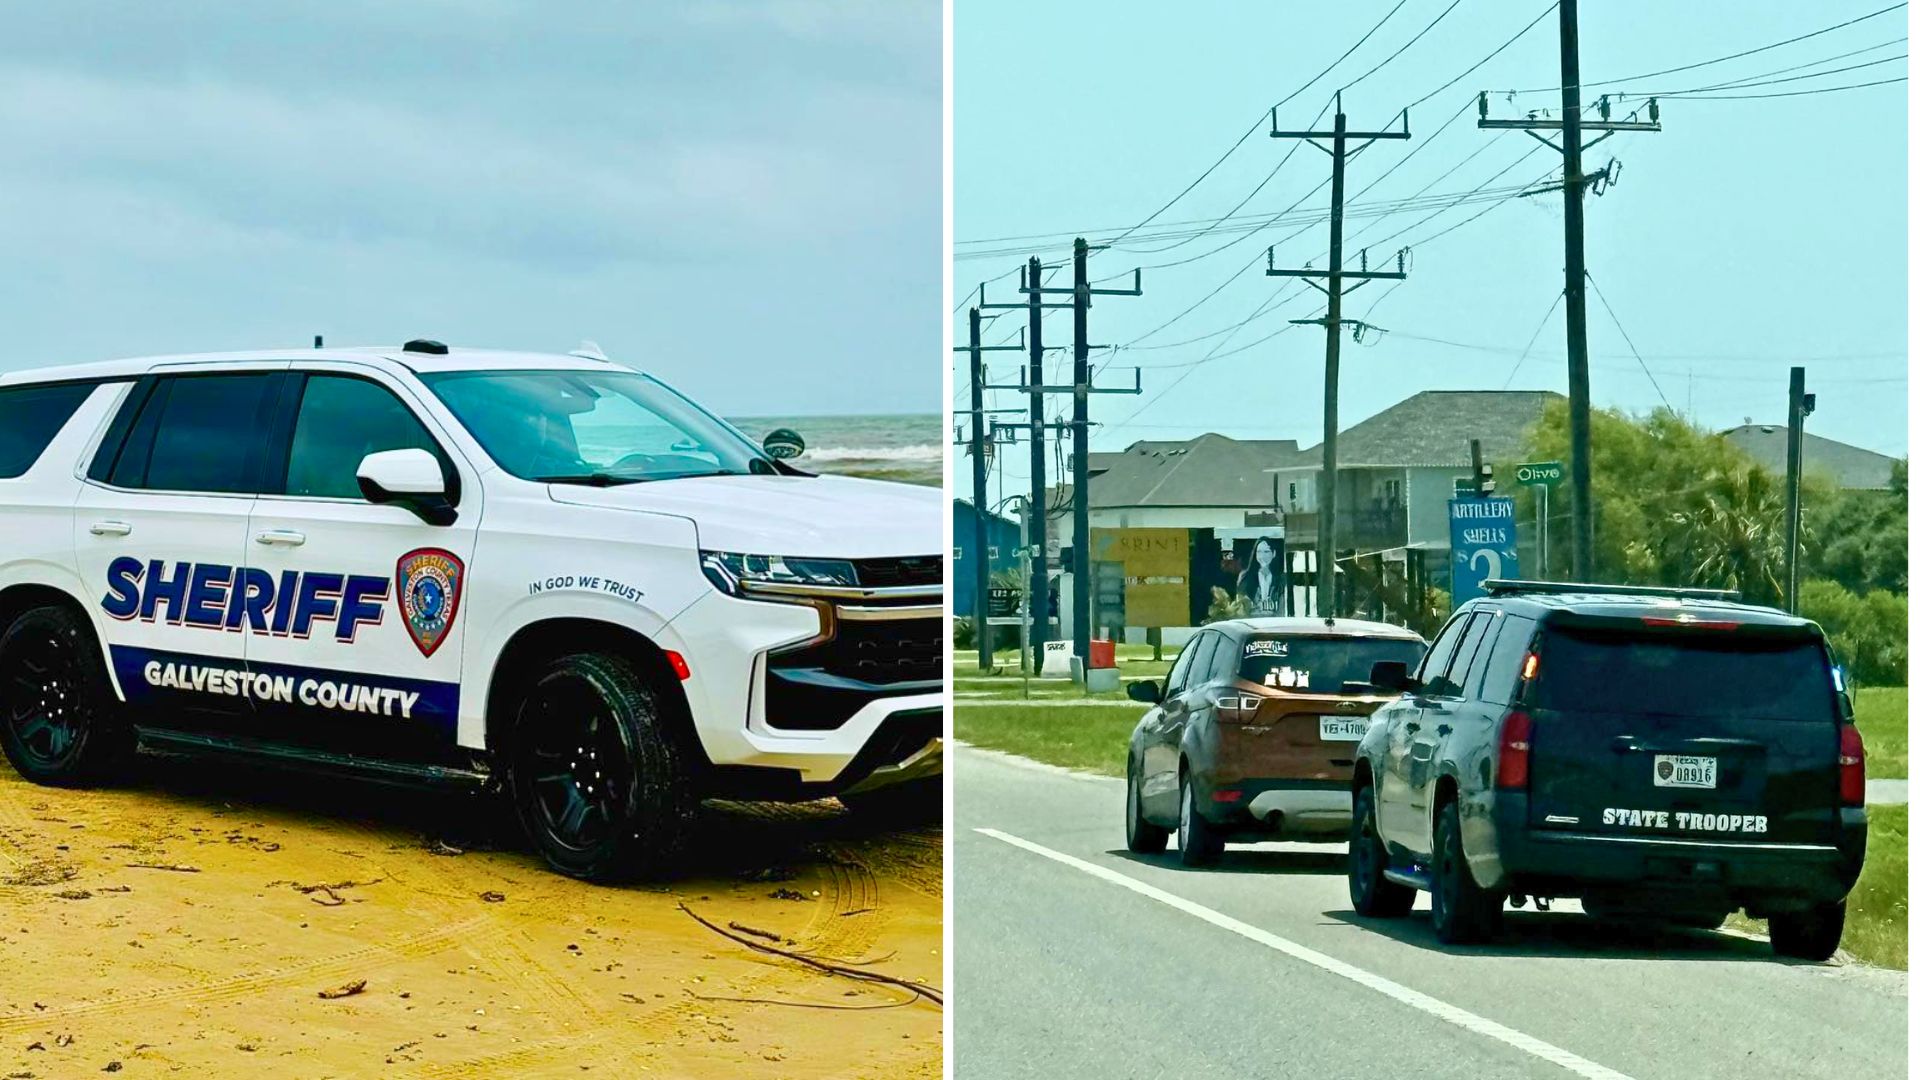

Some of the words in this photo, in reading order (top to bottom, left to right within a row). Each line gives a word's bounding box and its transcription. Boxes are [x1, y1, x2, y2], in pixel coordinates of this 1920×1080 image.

[1518, 468, 1560, 480] Olive
[1452, 503, 1513, 519] ARTILLERY
[1463, 528, 1506, 544] SHELLS
[101, 556, 391, 643] SHERIFF
[529, 580, 542, 595] IN
[546, 576, 574, 589] GOD
[579, 576, 600, 589] WE
[603, 579, 645, 603] TRUST
[144, 661, 294, 703] GALVESTON
[299, 679, 420, 718] COUNTY
[1602, 807, 1669, 828] STATE
[1675, 812, 1768, 833] TROOPER
